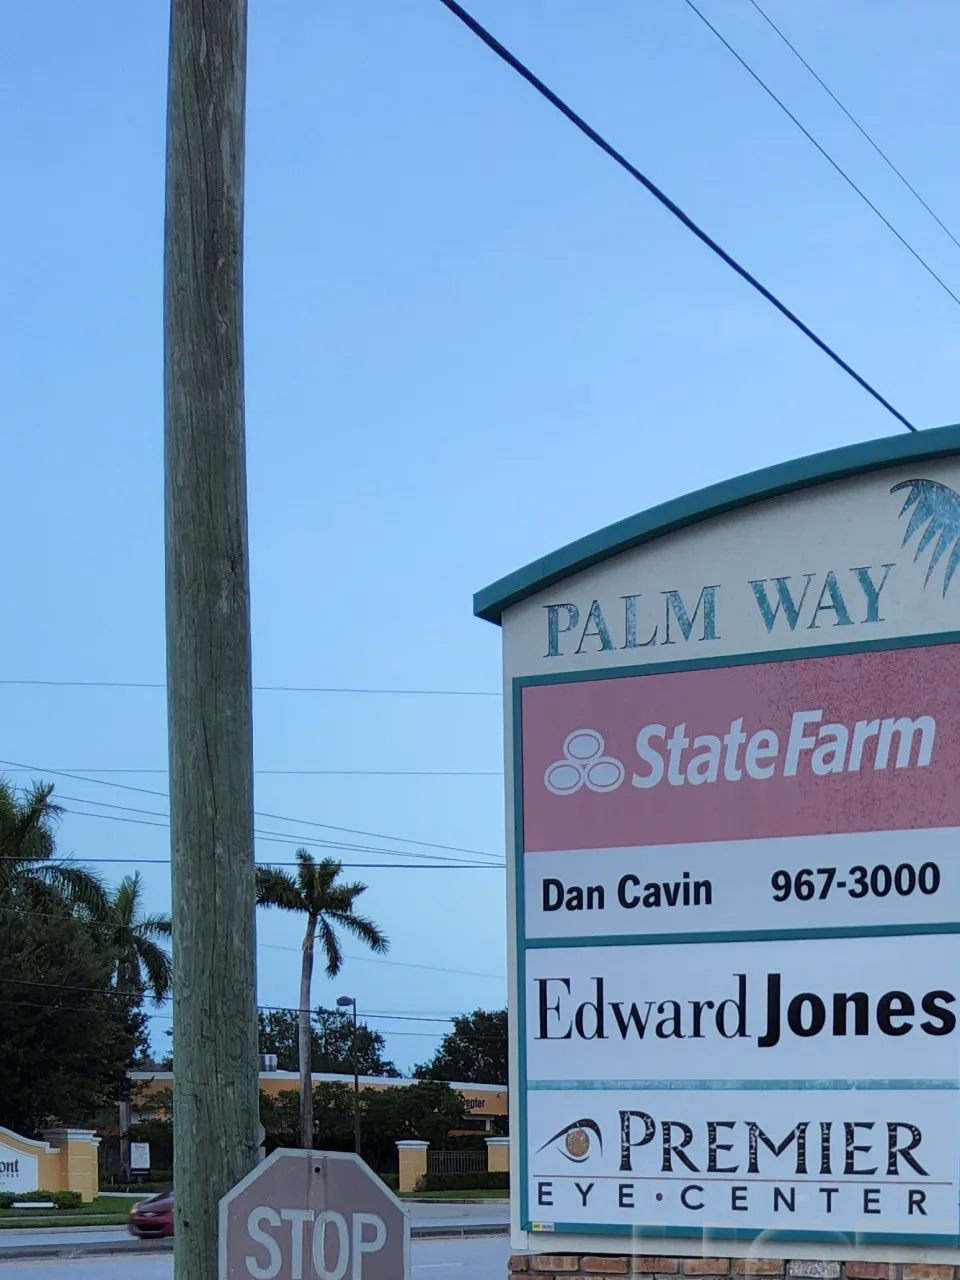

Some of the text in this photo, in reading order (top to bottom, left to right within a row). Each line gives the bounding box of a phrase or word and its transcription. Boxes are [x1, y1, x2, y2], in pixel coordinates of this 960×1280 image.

[543, 563, 896, 657] PALM WAY
[542, 862, 940, 912] Dan Cavin 967-3000
[618, 1110, 931, 1177] PREMIER
